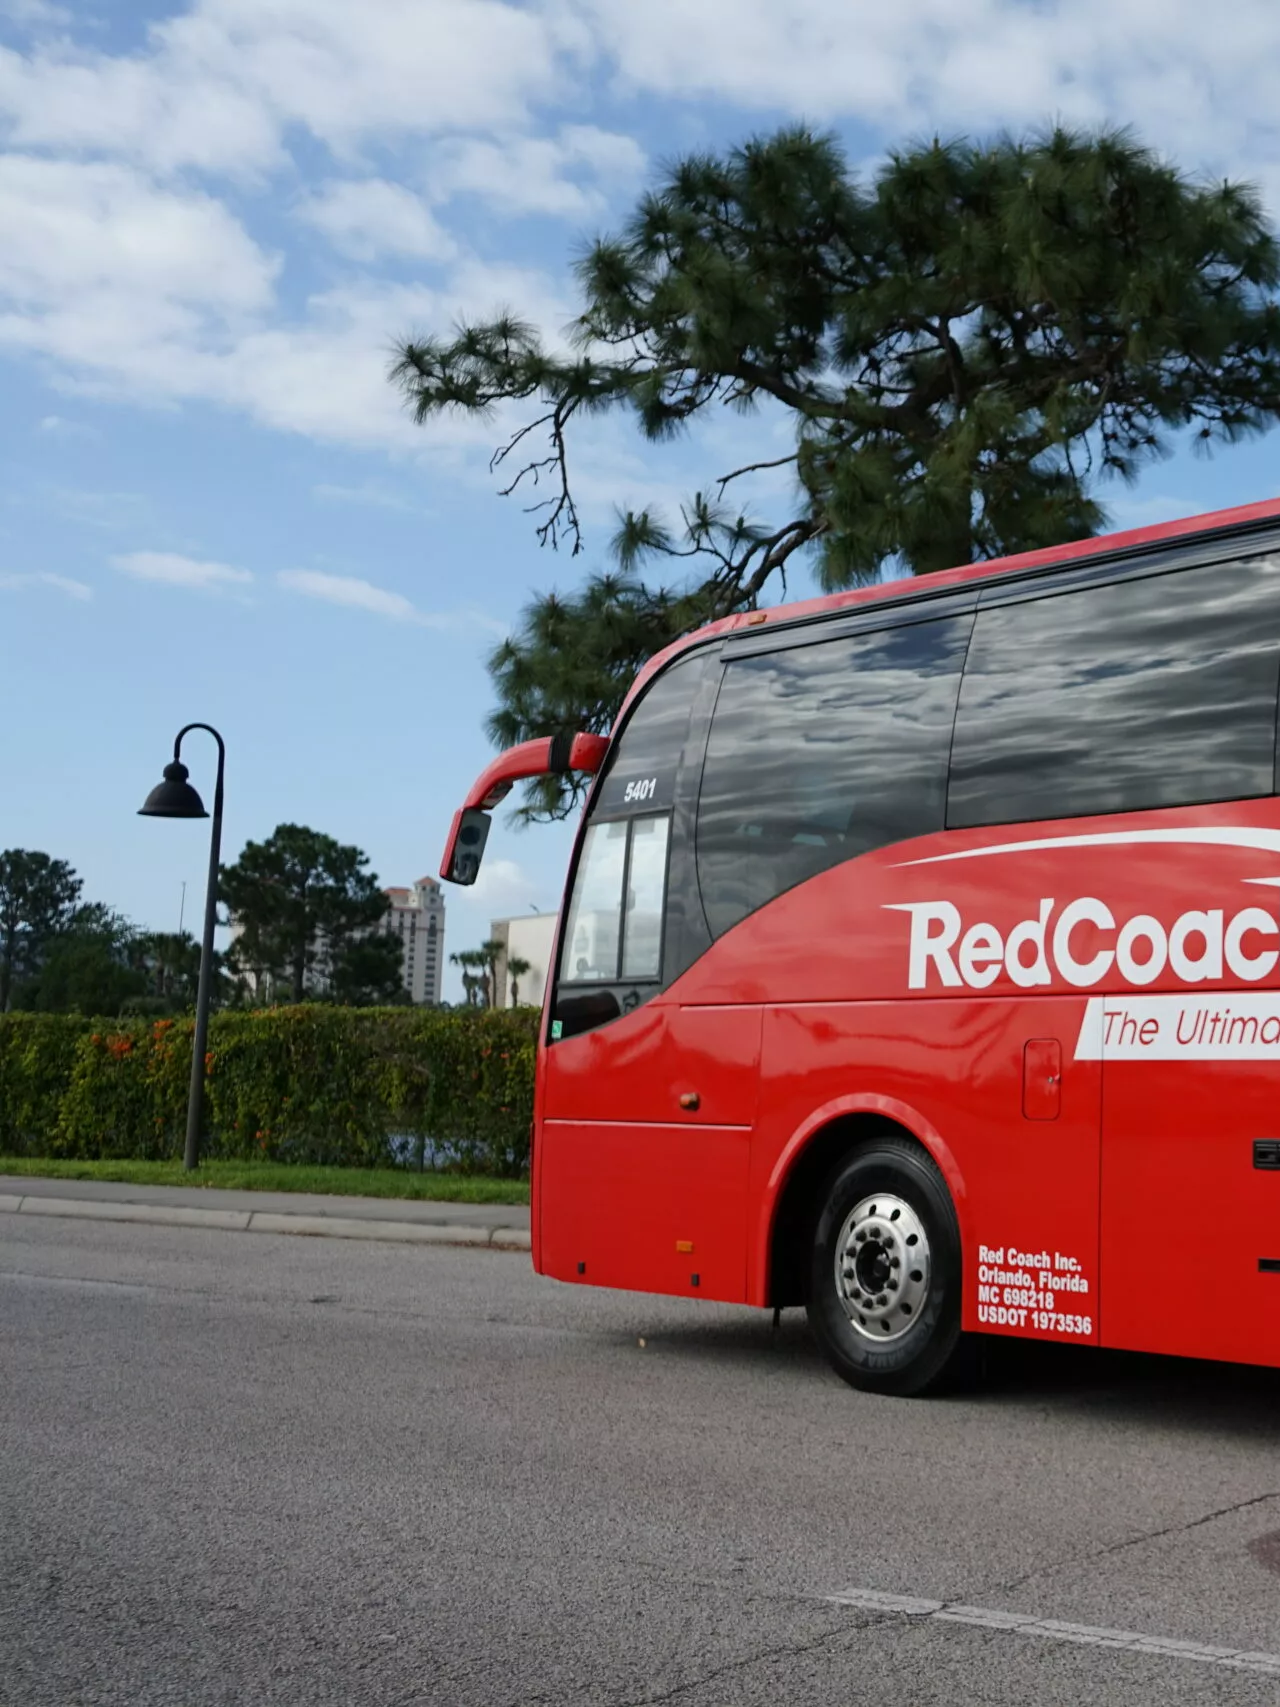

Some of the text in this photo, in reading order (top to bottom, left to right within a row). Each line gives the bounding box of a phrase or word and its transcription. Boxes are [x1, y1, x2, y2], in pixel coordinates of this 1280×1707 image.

[624, 778, 657, 803] 5401
[1104, 1011, 1159, 1046] The
[978, 1244, 1082, 1272] Red Coach Inc.
[978, 1265, 1089, 1293] Orlando, Florida
[978, 1284, 1055, 1310] MC 698218
[977, 1304, 1092, 1335] USDOT 1973536
